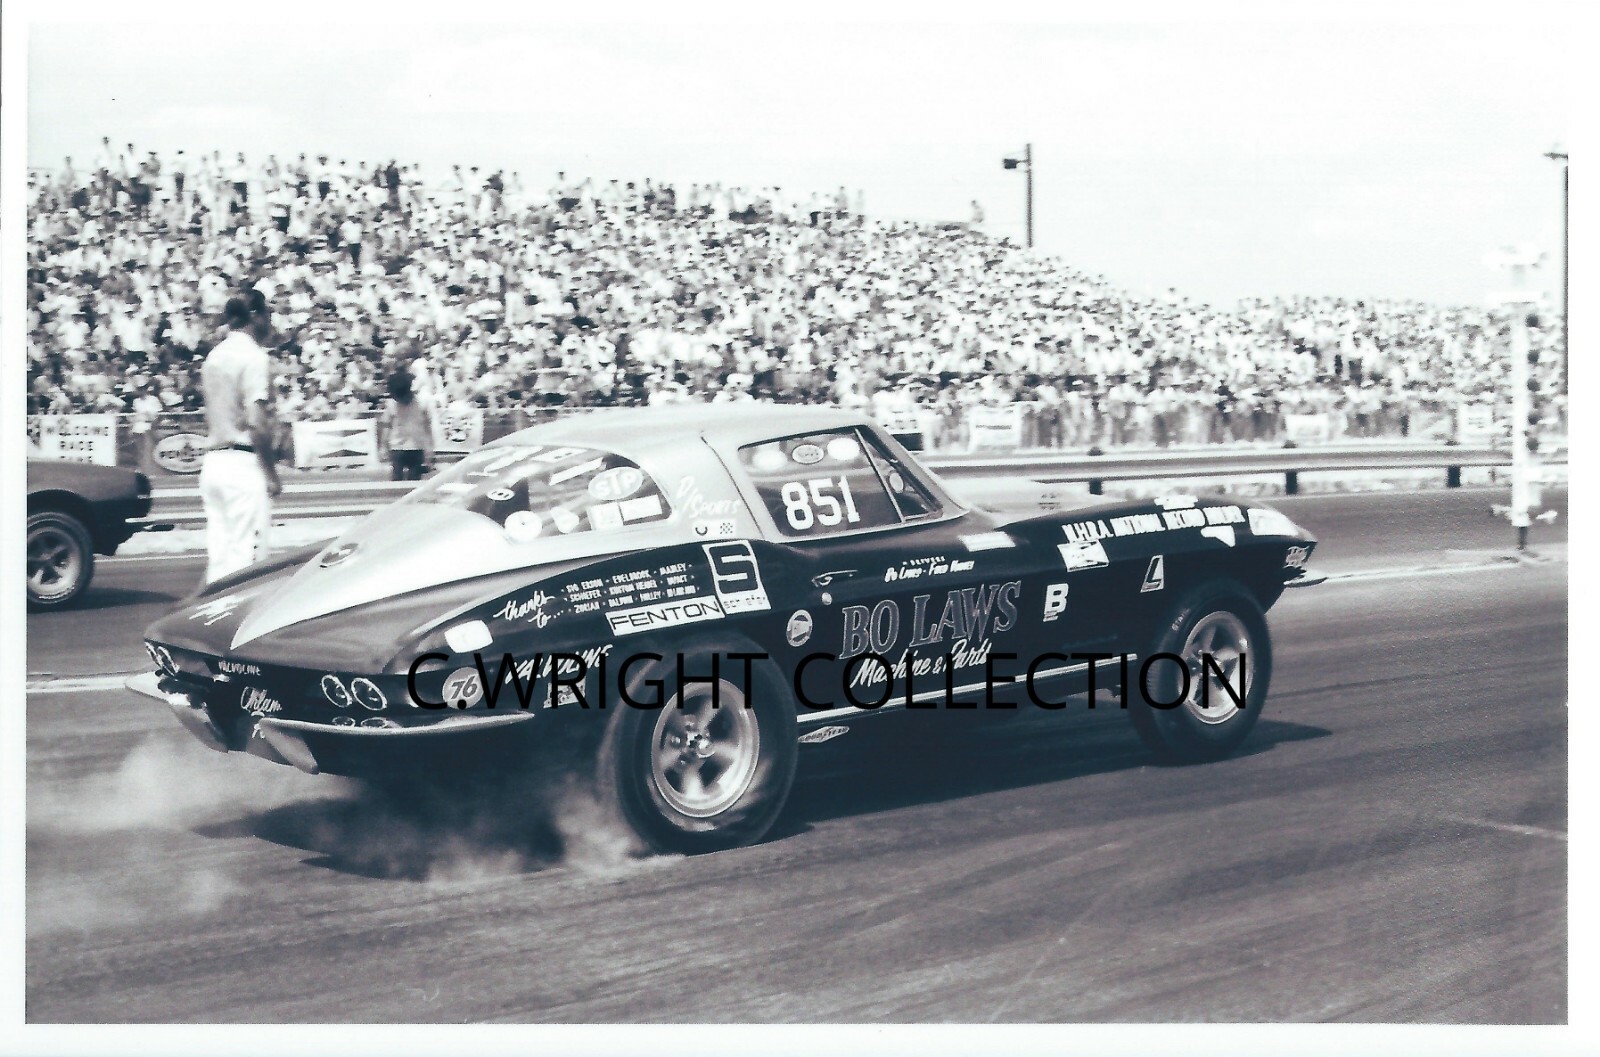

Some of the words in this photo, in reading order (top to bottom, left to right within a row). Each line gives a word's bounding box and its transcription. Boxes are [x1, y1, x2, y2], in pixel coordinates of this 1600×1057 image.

[60, 440, 94, 452] RACE
[594, 468, 639, 495] STP
[780, 474, 861, 531] 851
[708, 543, 759, 594] S
[492, 590, 556, 622] thanks
[1043, 582, 1069, 613] B
[608, 598, 724, 631] FENTON
[839, 600, 900, 660] BO
[909, 580, 1022, 648] LAWS
[849, 648, 932, 689] Machine
[943, 638, 993, 673] Parts
[450, 674, 478, 700] 76
